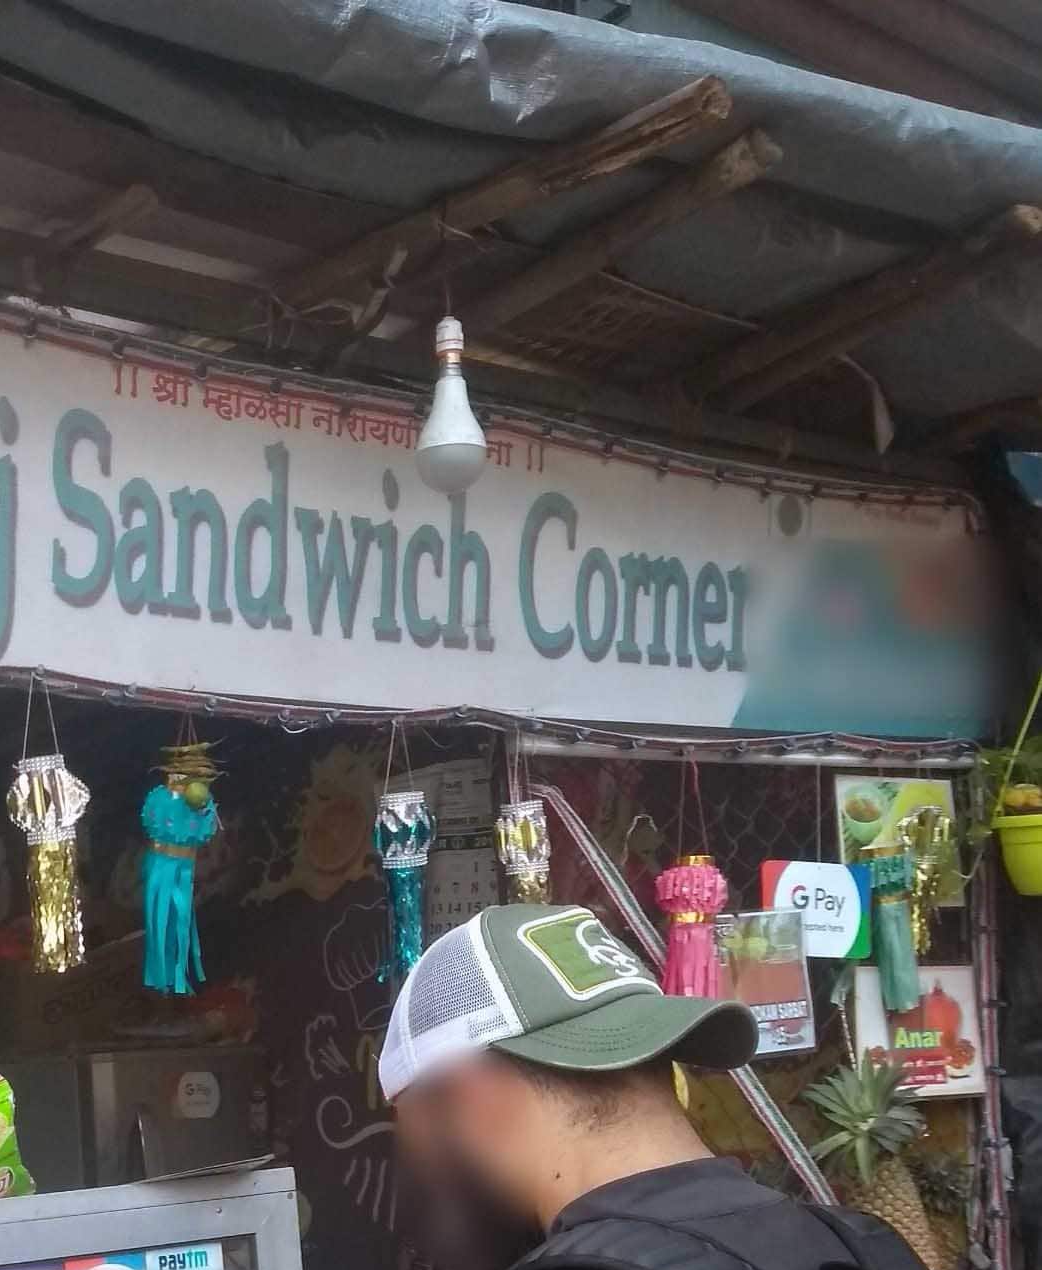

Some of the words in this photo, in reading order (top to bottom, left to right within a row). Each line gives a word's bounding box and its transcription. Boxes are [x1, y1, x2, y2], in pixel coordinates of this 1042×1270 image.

[50, 408, 496, 651] Sandwich
[518, 490, 750, 672] Corner
[814, 887, 847, 918] Pay
[893, 1026, 944, 1049] Anar
